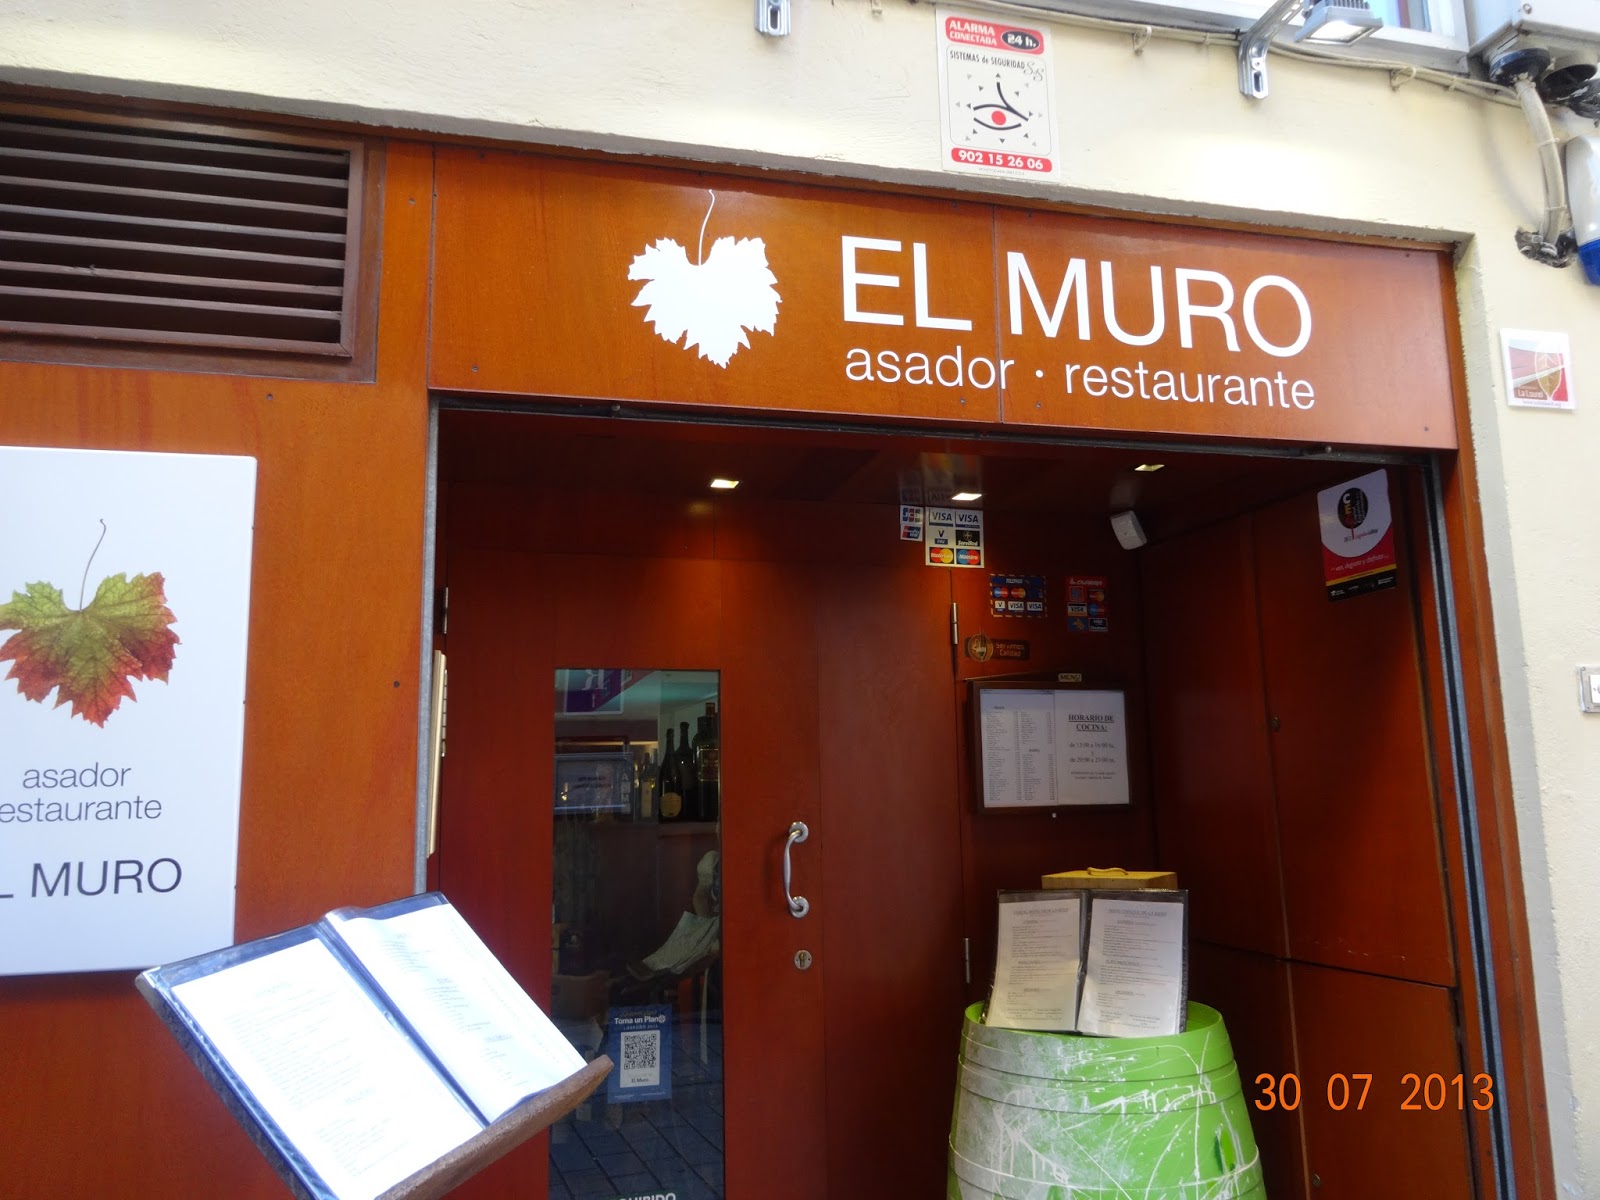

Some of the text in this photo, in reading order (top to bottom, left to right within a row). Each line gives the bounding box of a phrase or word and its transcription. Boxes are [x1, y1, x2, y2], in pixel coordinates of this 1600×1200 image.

[950, 20, 995, 36] ALARMA
[950, 31, 997, 46] CONECTADA
[1007, 33, 1023, 46] 24
[950, 51, 1025, 70] SISTEMAS de SEGURIDAD
[959, 149, 1044, 170] 902 15 26 06
[841, 235, 1313, 358] EL MURO
[845, 345, 1315, 411] asador restaurante
[932, 512, 953, 521] VISA
[958, 514, 979, 523] VISA
[1068, 714, 1103, 722] HORARIO
[22, 761, 132, 789] asador
[0, 795, 162, 823] estaurante
[31, 857, 182, 898] MURO
[614, 1017, 633, 1025] Toma
